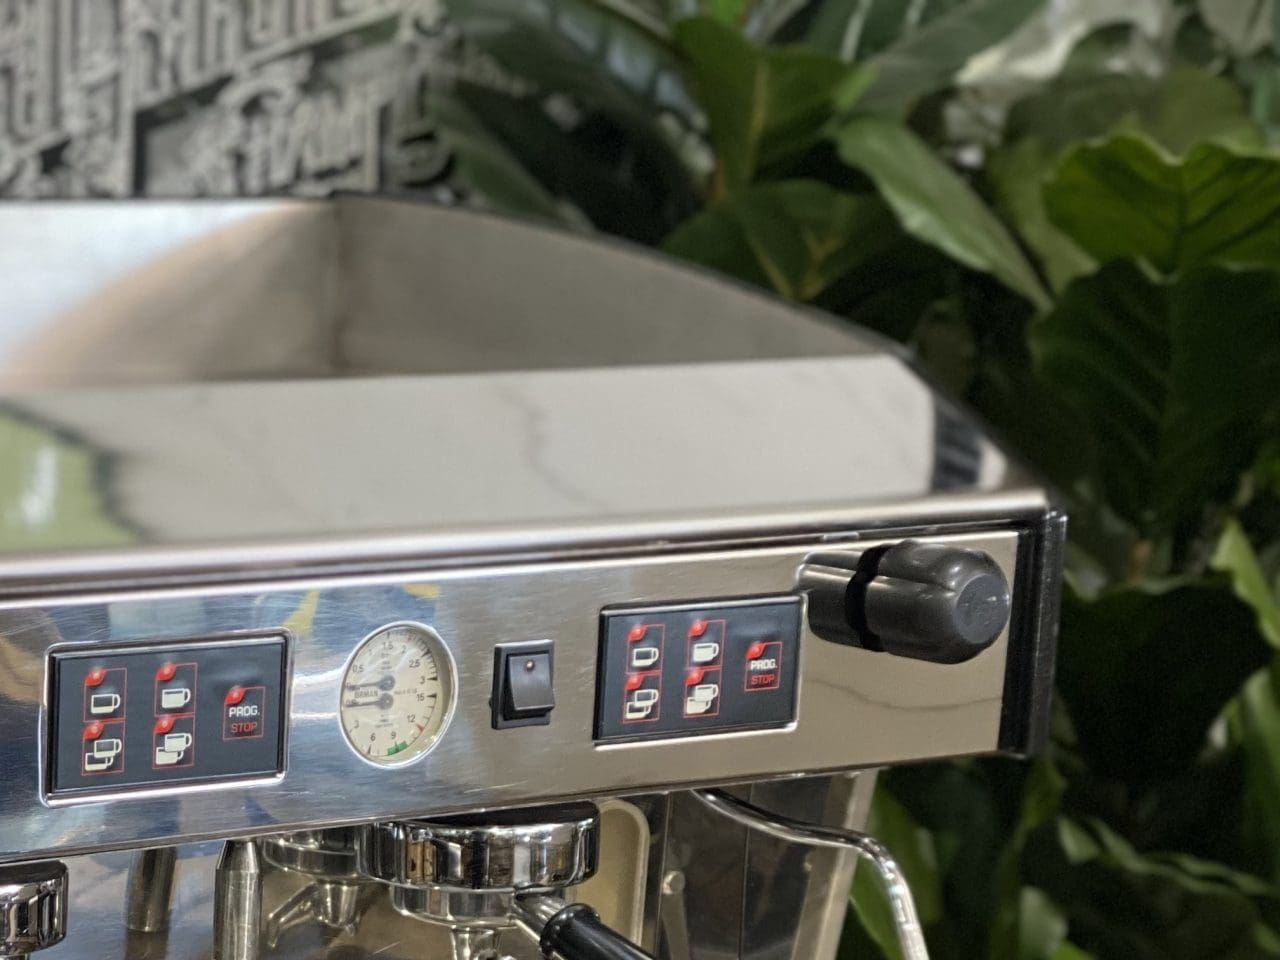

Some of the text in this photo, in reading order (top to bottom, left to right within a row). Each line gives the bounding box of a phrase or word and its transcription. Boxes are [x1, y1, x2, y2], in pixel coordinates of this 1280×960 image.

[750, 658, 777, 670] PROG.
[419, 675, 426, 685] 3
[751, 674, 775, 685] STOP
[416, 692, 425, 702] 15
[228, 705, 260, 717] PROG.
[406, 713, 416, 723] 12
[231, 721, 257, 733] STOP
